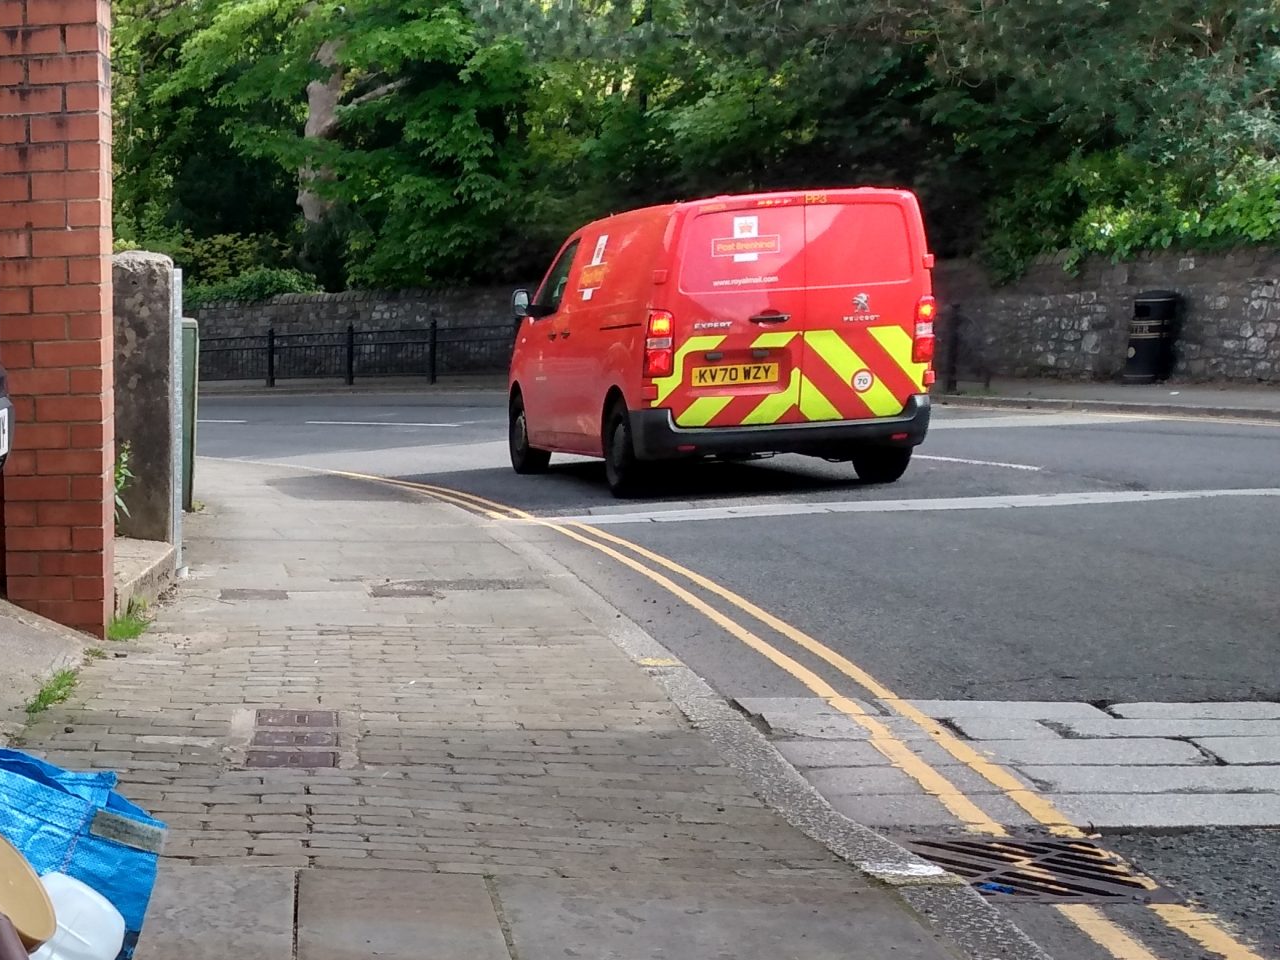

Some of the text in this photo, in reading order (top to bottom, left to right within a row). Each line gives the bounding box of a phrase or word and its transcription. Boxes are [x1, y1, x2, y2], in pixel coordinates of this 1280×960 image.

[713, 275, 779, 287] www.royalmail.com
[694, 321, 733, 329] EXPERT
[698, 366, 772, 384] KV70 WZY
